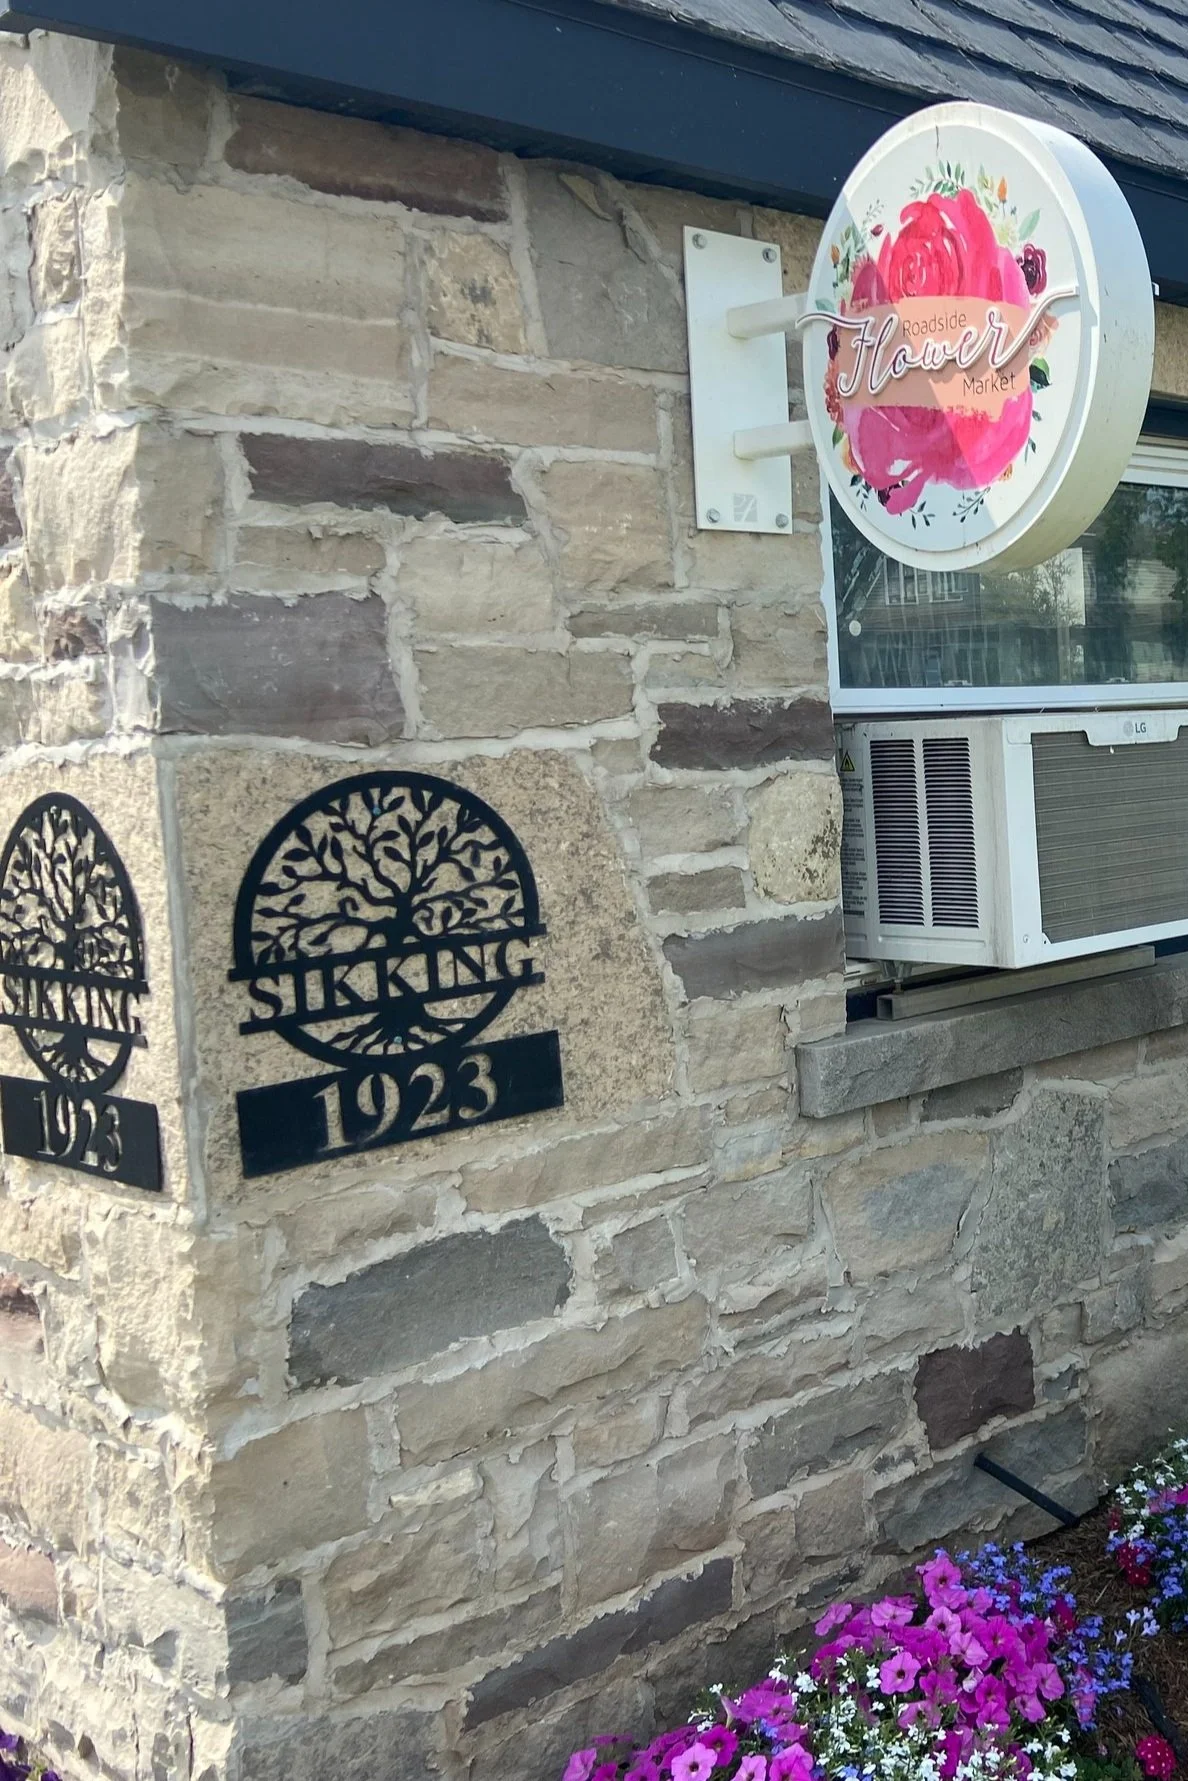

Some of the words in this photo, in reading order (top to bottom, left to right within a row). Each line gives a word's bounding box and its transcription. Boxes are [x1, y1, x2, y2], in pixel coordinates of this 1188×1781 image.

[795, 285, 1079, 397] Flower
[902, 310, 967, 338] Roadside
[962, 371, 1016, 397] Market
[1135, 722, 1147, 734] LG
[249, 937, 535, 1020] SIKKING
[33, 1088, 123, 1173] 1923
[312, 1051, 499, 1152] 1923
